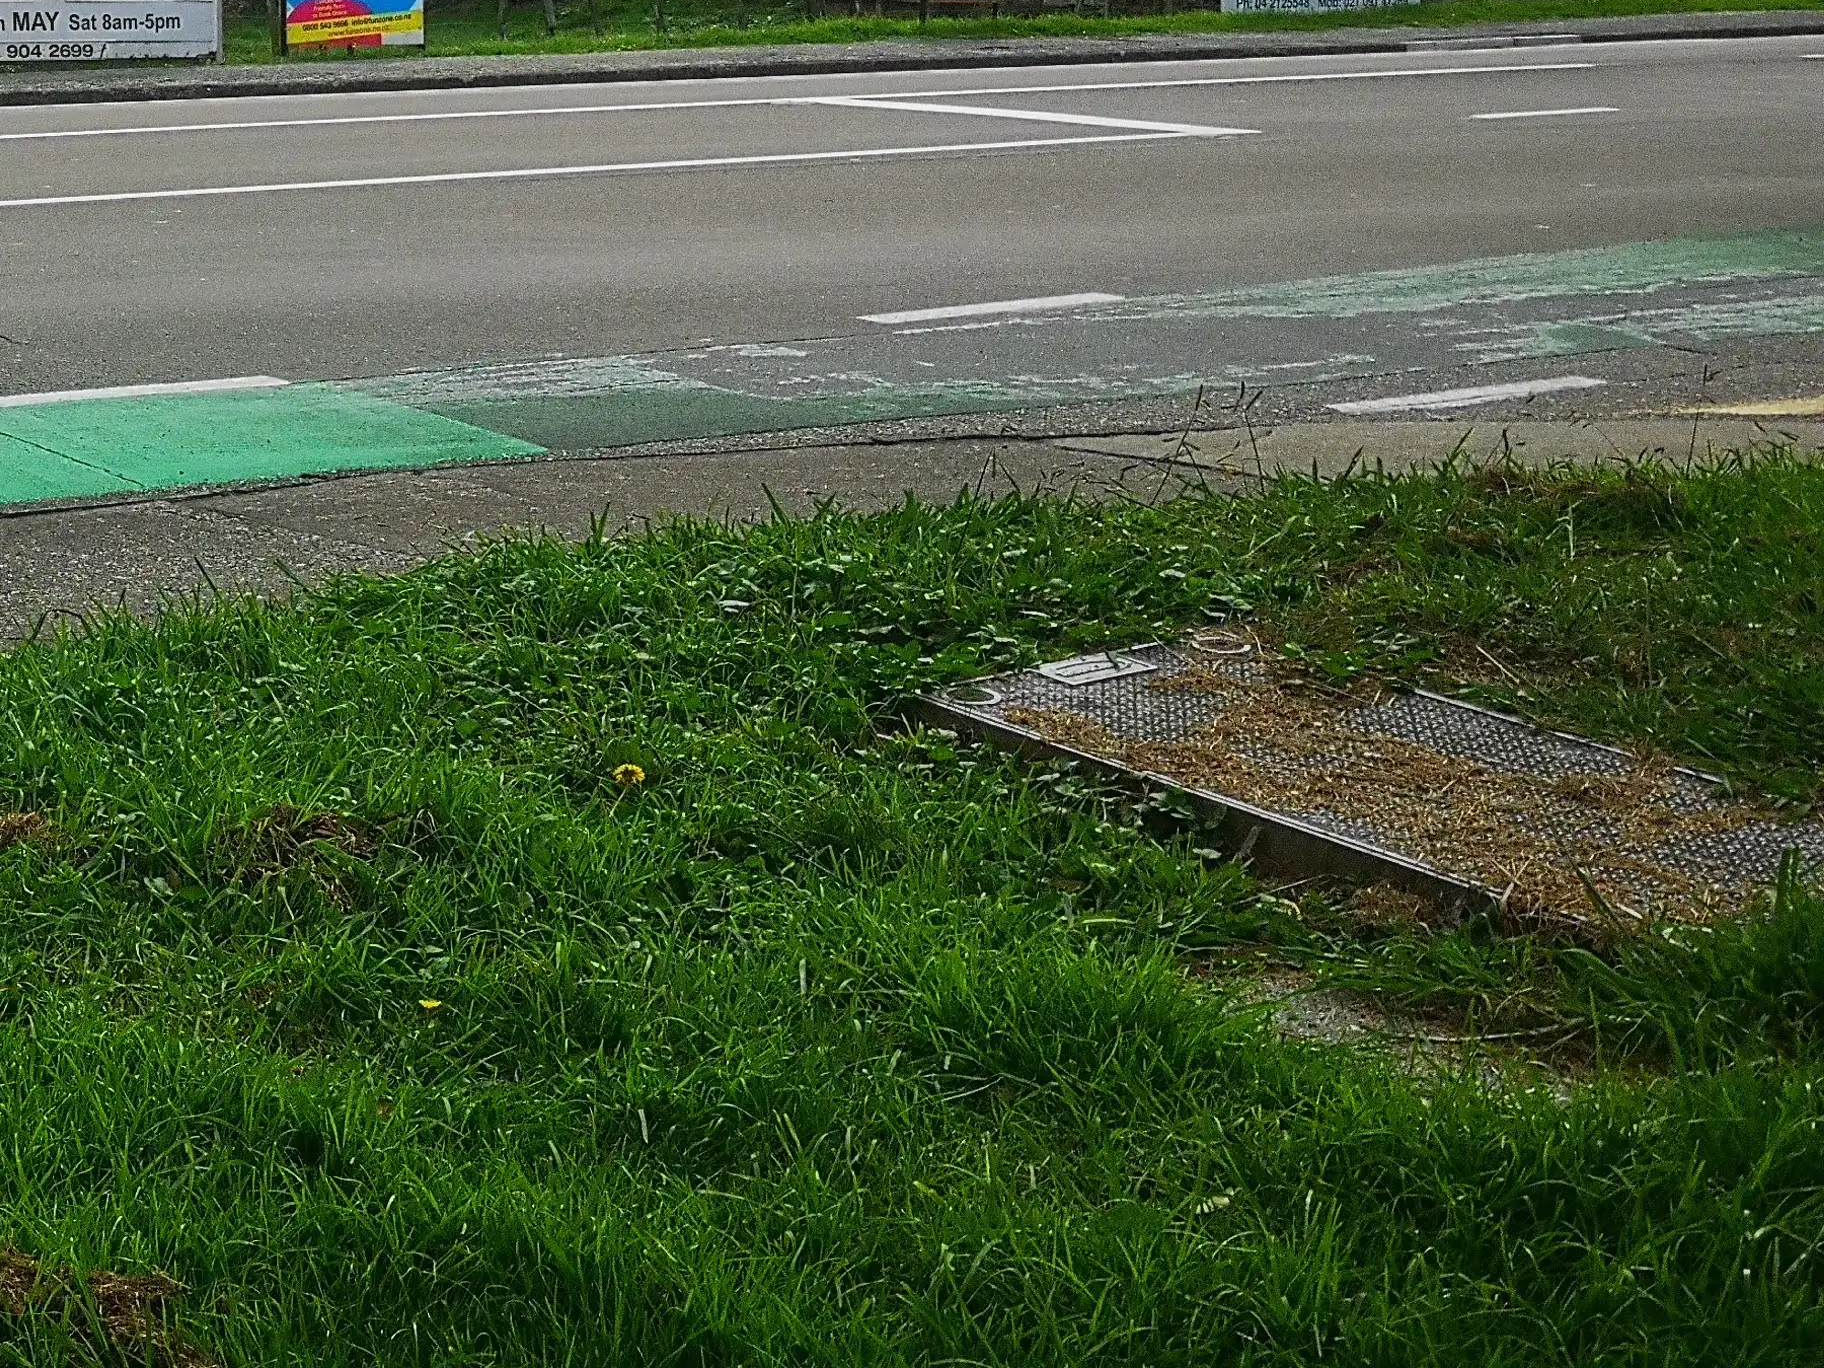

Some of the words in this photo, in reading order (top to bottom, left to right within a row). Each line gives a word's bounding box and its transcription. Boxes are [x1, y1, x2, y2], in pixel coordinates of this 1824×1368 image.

[13, 12, 59, 31] MAY
[69, 14, 97, 31] Sat
[102, 14, 181, 33] 8am-5pm
[7, 45, 42, 59] 904
[49, 44, 94, 58] 2699
